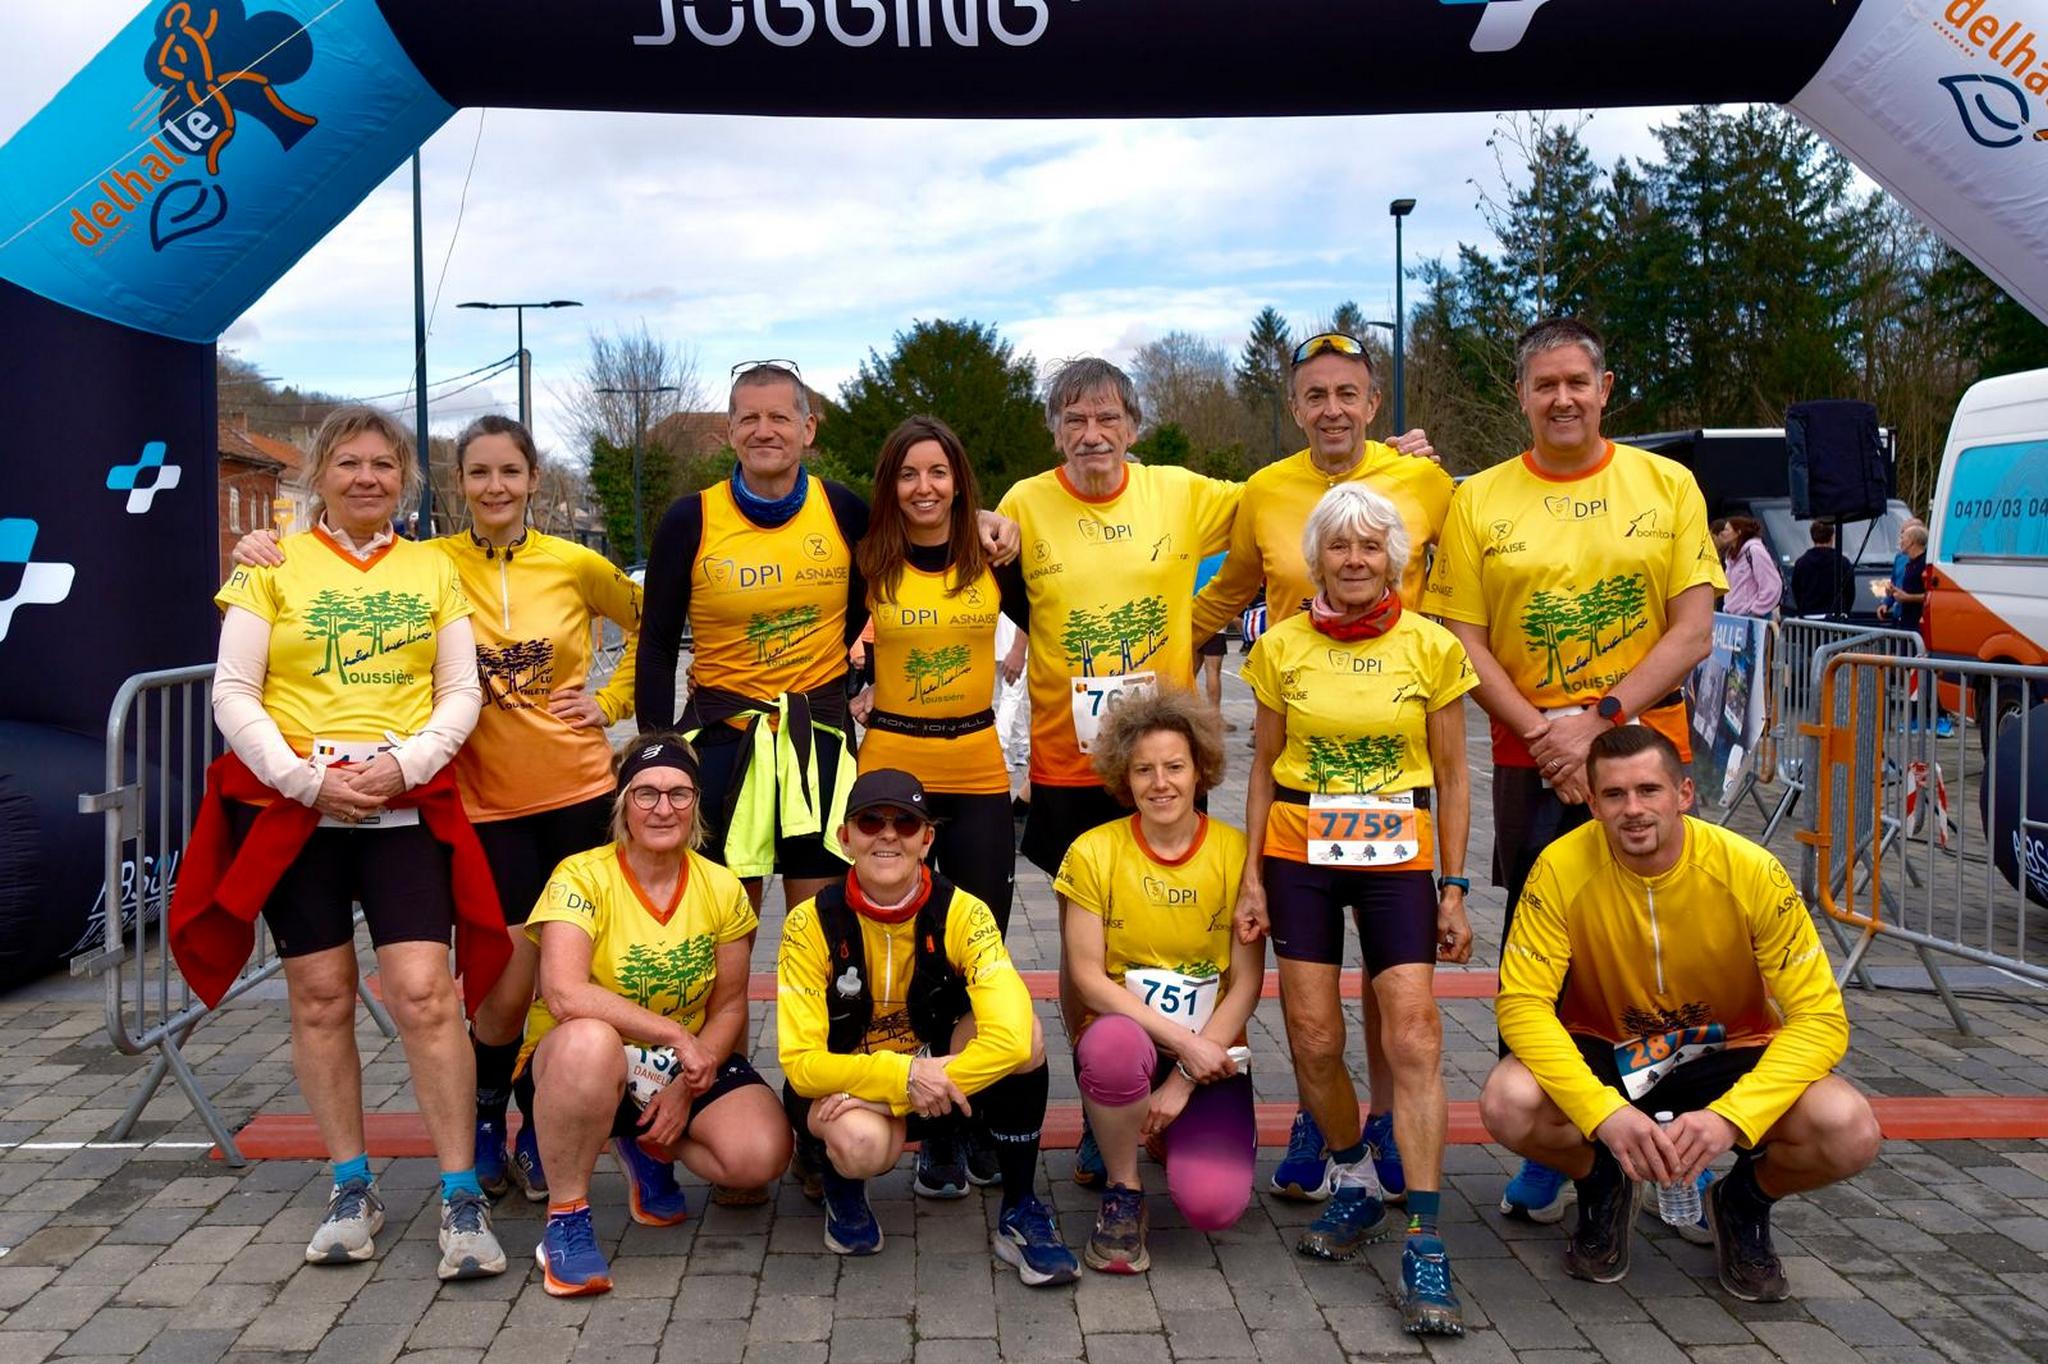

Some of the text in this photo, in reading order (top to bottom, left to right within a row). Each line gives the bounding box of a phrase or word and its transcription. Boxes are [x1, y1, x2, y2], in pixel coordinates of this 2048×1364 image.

[1944, 0, 2048, 96] delha
[71, 111, 218, 246] delhalle
[1575, 498, 1607, 518] DPI
[1955, 499, 2021, 519] 0470/03
[1104, 524, 1132, 540] DPI
[231, 571, 249, 589] PI
[740, 564, 781, 587] DPI
[901, 609, 938, 625] DPI
[1352, 658, 1382, 673] DPI
[1571, 667, 1629, 692] oussiè
[1321, 813, 1403, 839] 7759
[567, 893, 596, 918] DPI
[1168, 889, 1198, 904] DPI
[1143, 979, 1197, 1016] 751
